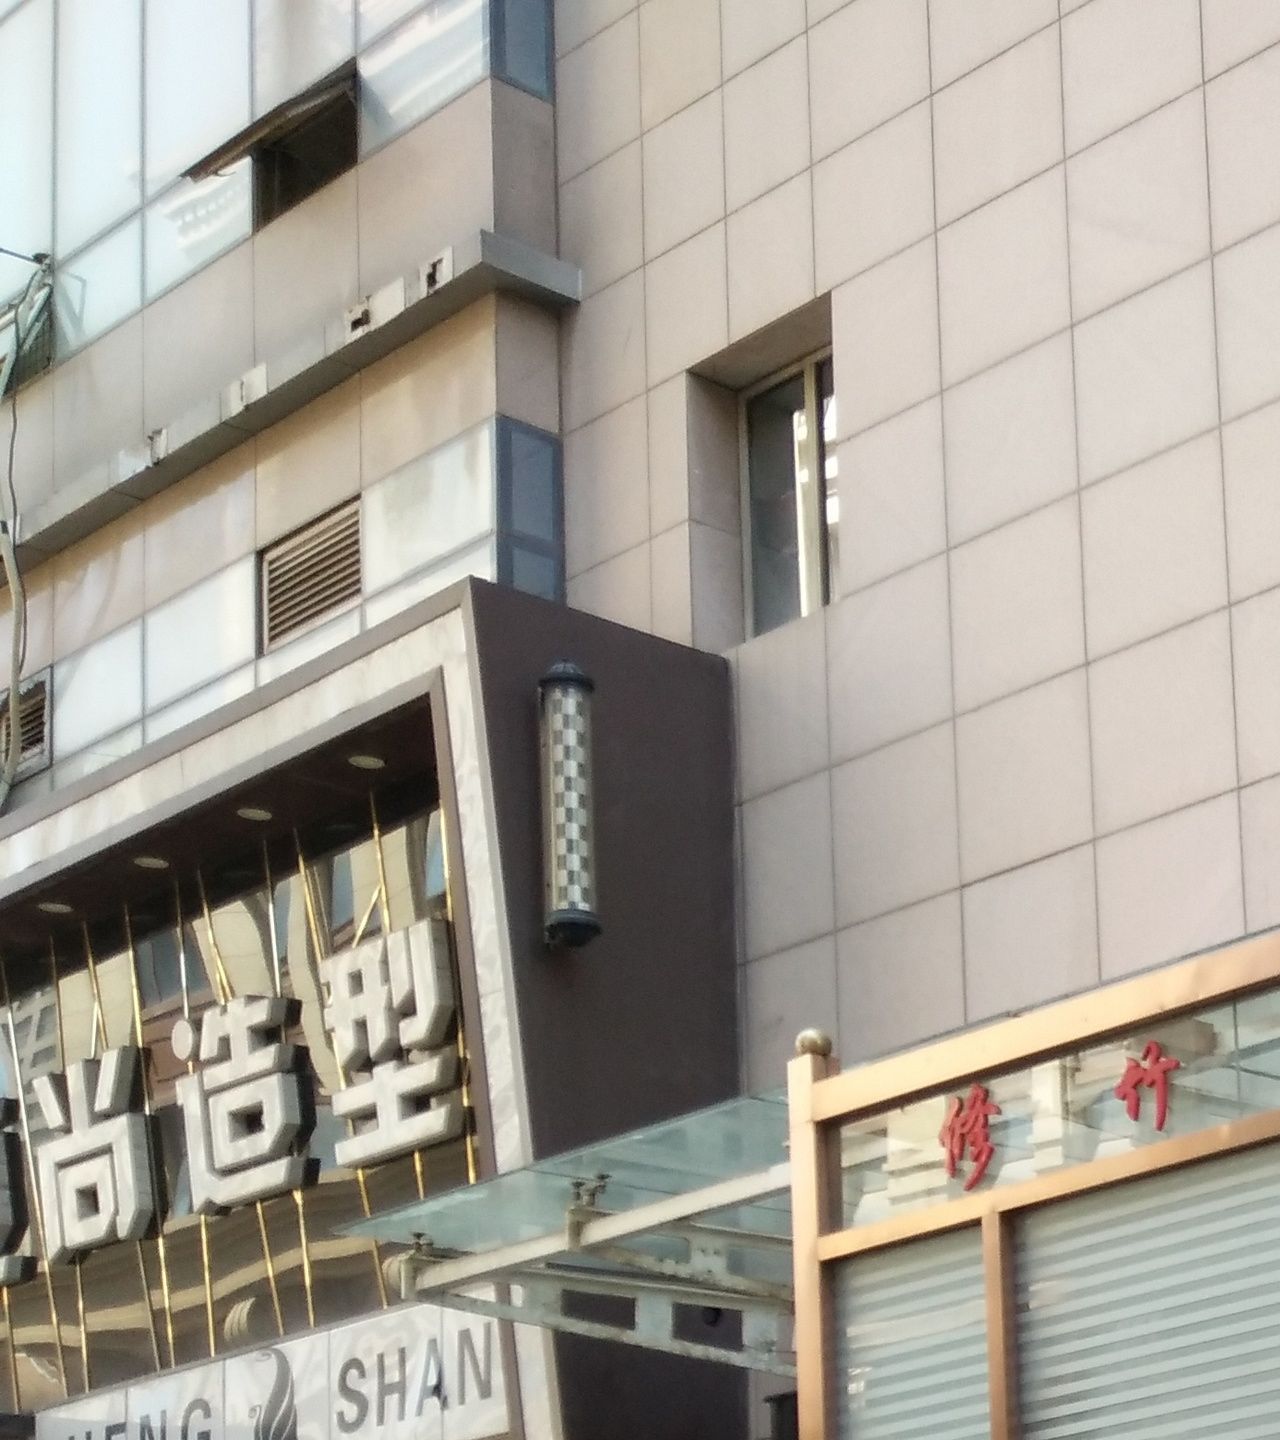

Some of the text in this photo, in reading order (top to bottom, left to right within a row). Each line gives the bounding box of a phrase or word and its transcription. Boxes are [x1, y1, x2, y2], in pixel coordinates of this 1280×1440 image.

[0, 917, 464, 1287] 尚造型
[336, 1321, 493, 1435] SHAN
